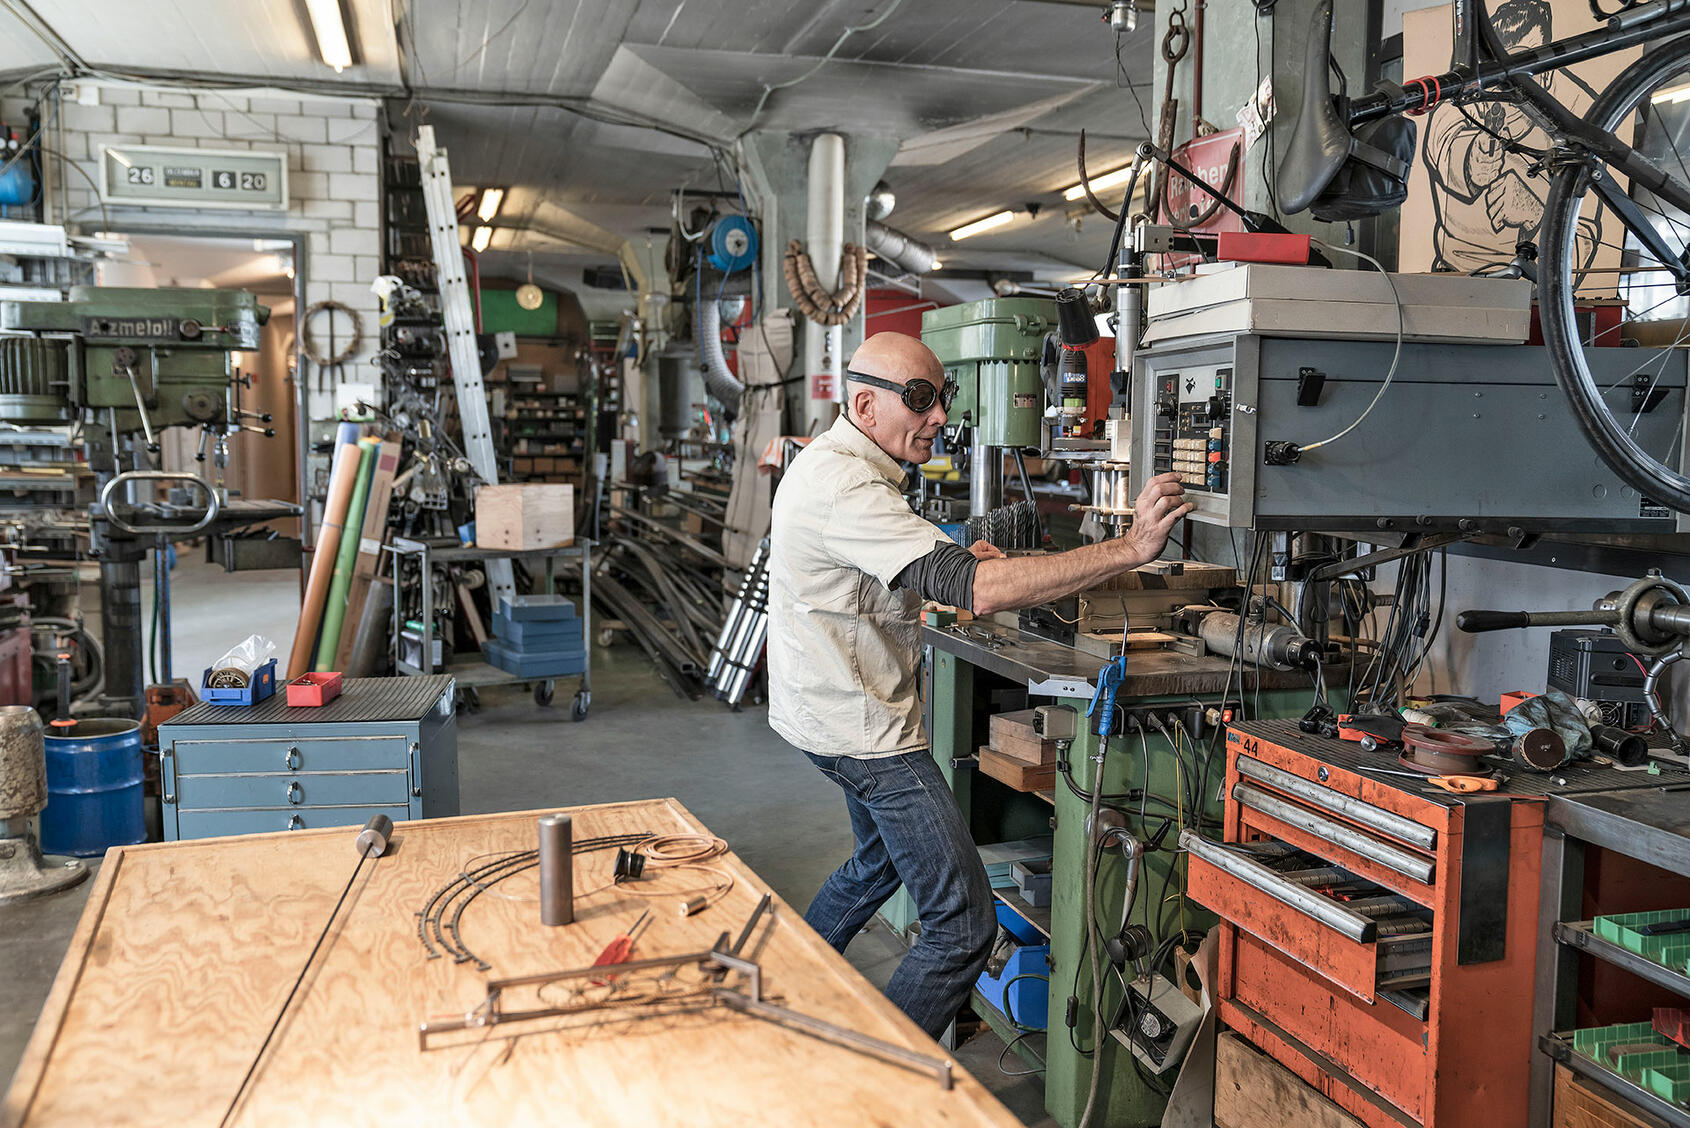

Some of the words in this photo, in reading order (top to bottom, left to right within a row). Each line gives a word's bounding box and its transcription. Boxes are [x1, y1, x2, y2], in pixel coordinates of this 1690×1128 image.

[128, 167, 153, 183] 26
[218, 172, 231, 188] 6
[242, 174, 265, 190] 20
[1243, 738, 1258, 757] 44
